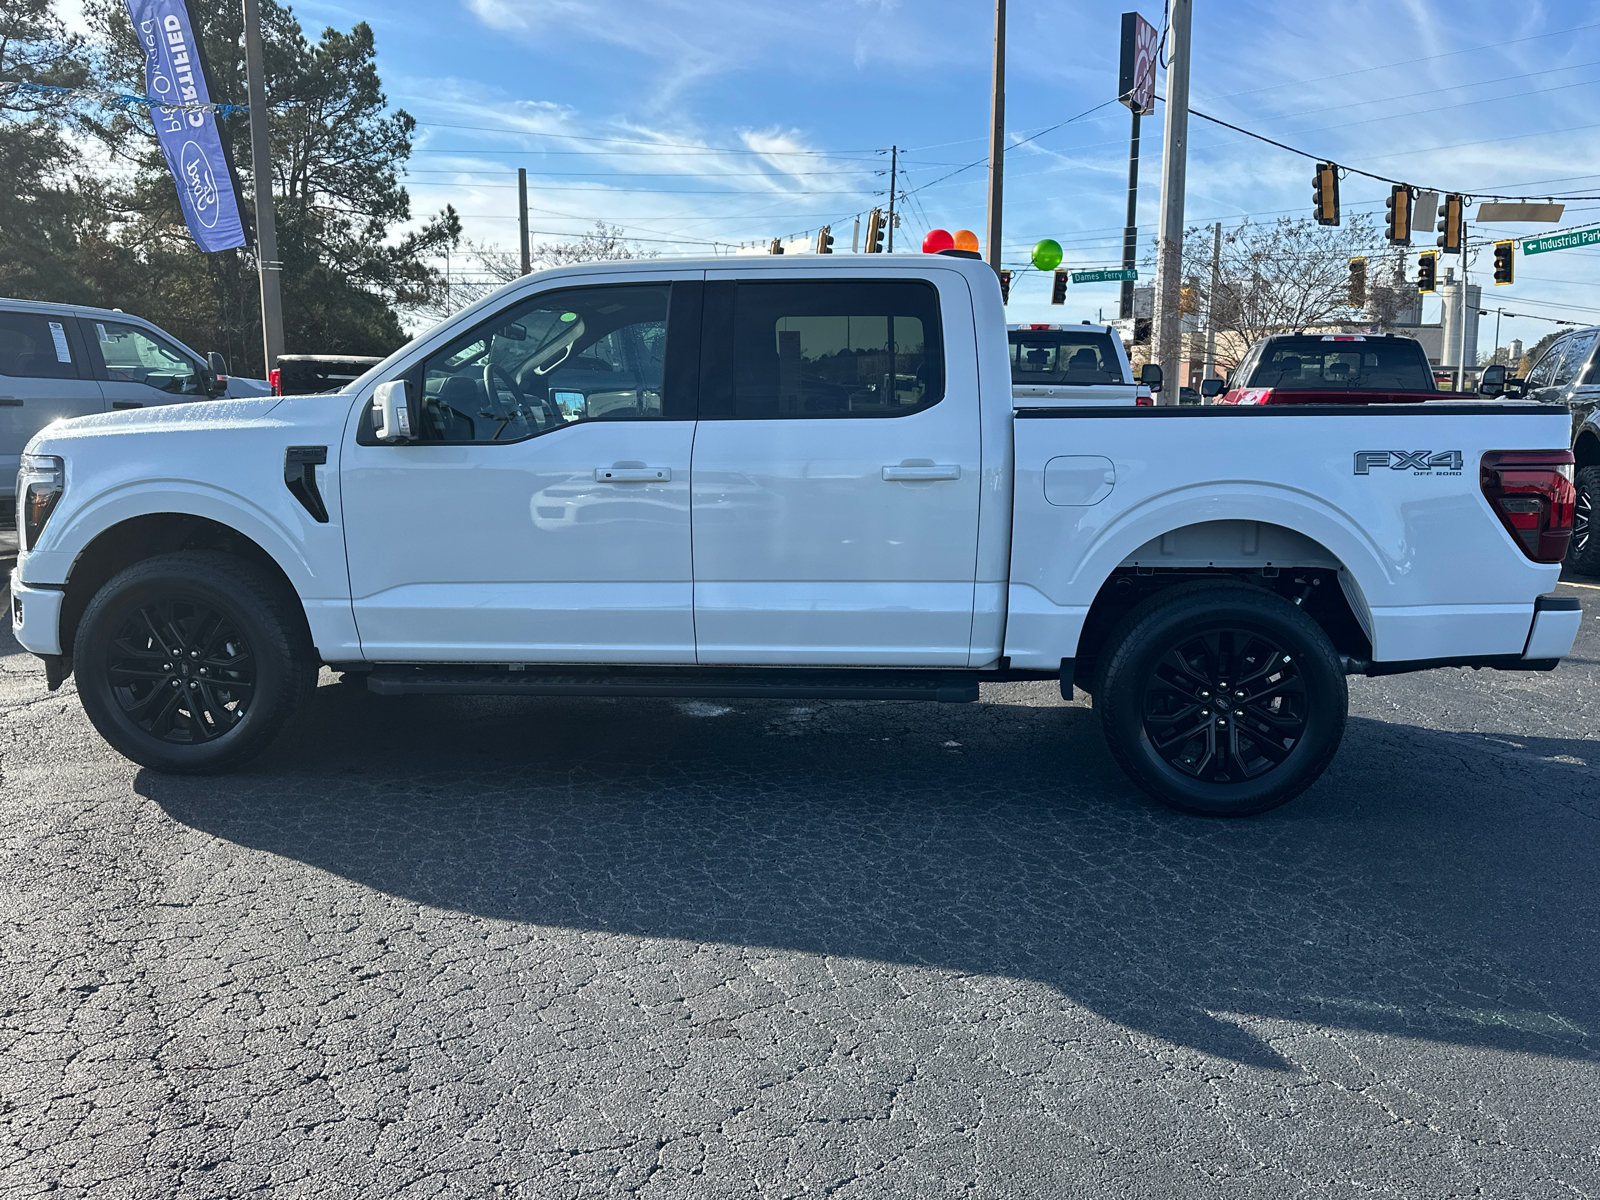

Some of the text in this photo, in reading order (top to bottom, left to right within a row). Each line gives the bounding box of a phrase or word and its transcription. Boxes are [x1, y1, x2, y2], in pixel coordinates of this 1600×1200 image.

[1540, 234, 1579, 250] Industrial
[1075, 270, 1136, 282] Dames Ferry Rd
[1354, 450, 1463, 476] FX4
